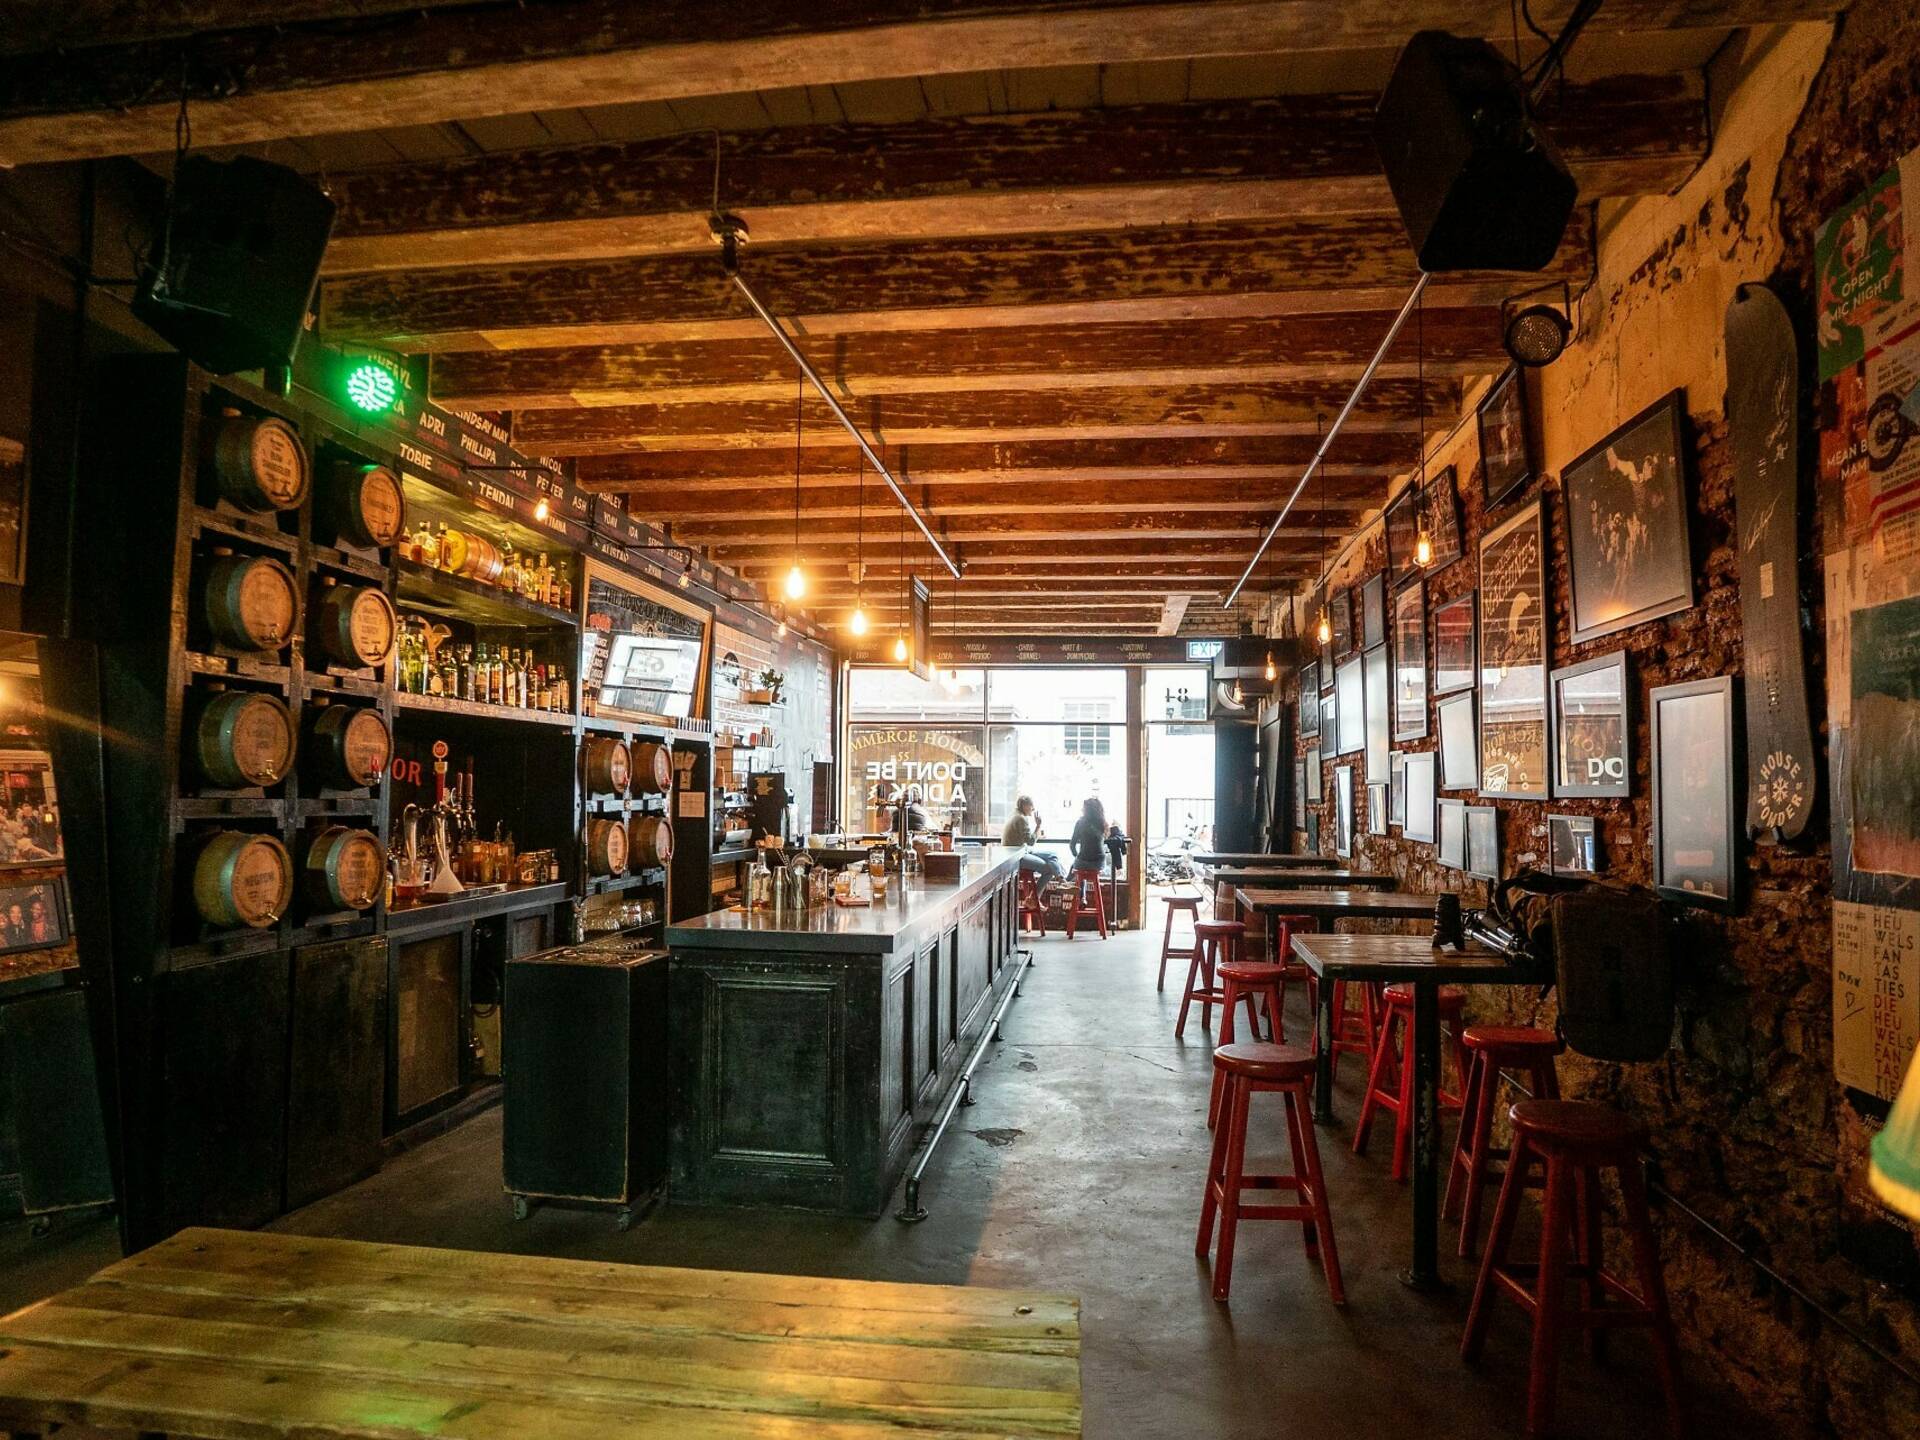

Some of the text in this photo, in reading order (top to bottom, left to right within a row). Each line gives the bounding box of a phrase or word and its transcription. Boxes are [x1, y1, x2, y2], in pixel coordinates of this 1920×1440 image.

[1842, 266, 1873, 297] OPEN
[1853, 274, 1891, 310] NIGHT
[419, 412, 446, 436] ADRI
[491, 425, 510, 445] MAY
[400, 443, 433, 471] TOBIE
[460, 434, 497, 464] PHILLIPA
[1827, 443, 1857, 468] MEAN
[479, 481, 514, 509] TENDAI
[572, 494, 587, 513] ASH
[1191, 642, 1220, 656] EXIT
[923, 730, 983, 767] HOUSE
[1760, 751, 1800, 780] HOUSE
[1758, 793, 1802, 828] POWDER
[1874, 913, 1902, 930] HEU
[1874, 929, 1914, 951] WELS
[1874, 946, 1901, 963] FAN
[1874, 961, 1900, 980] TAS
[1874, 978, 1905, 998] TIES
[1874, 995, 1897, 1012] DIE
[1874, 1010, 1901, 1030] HEU
[1874, 1043, 1901, 1062] FAN
[1874, 1059, 1900, 1080] TAS
